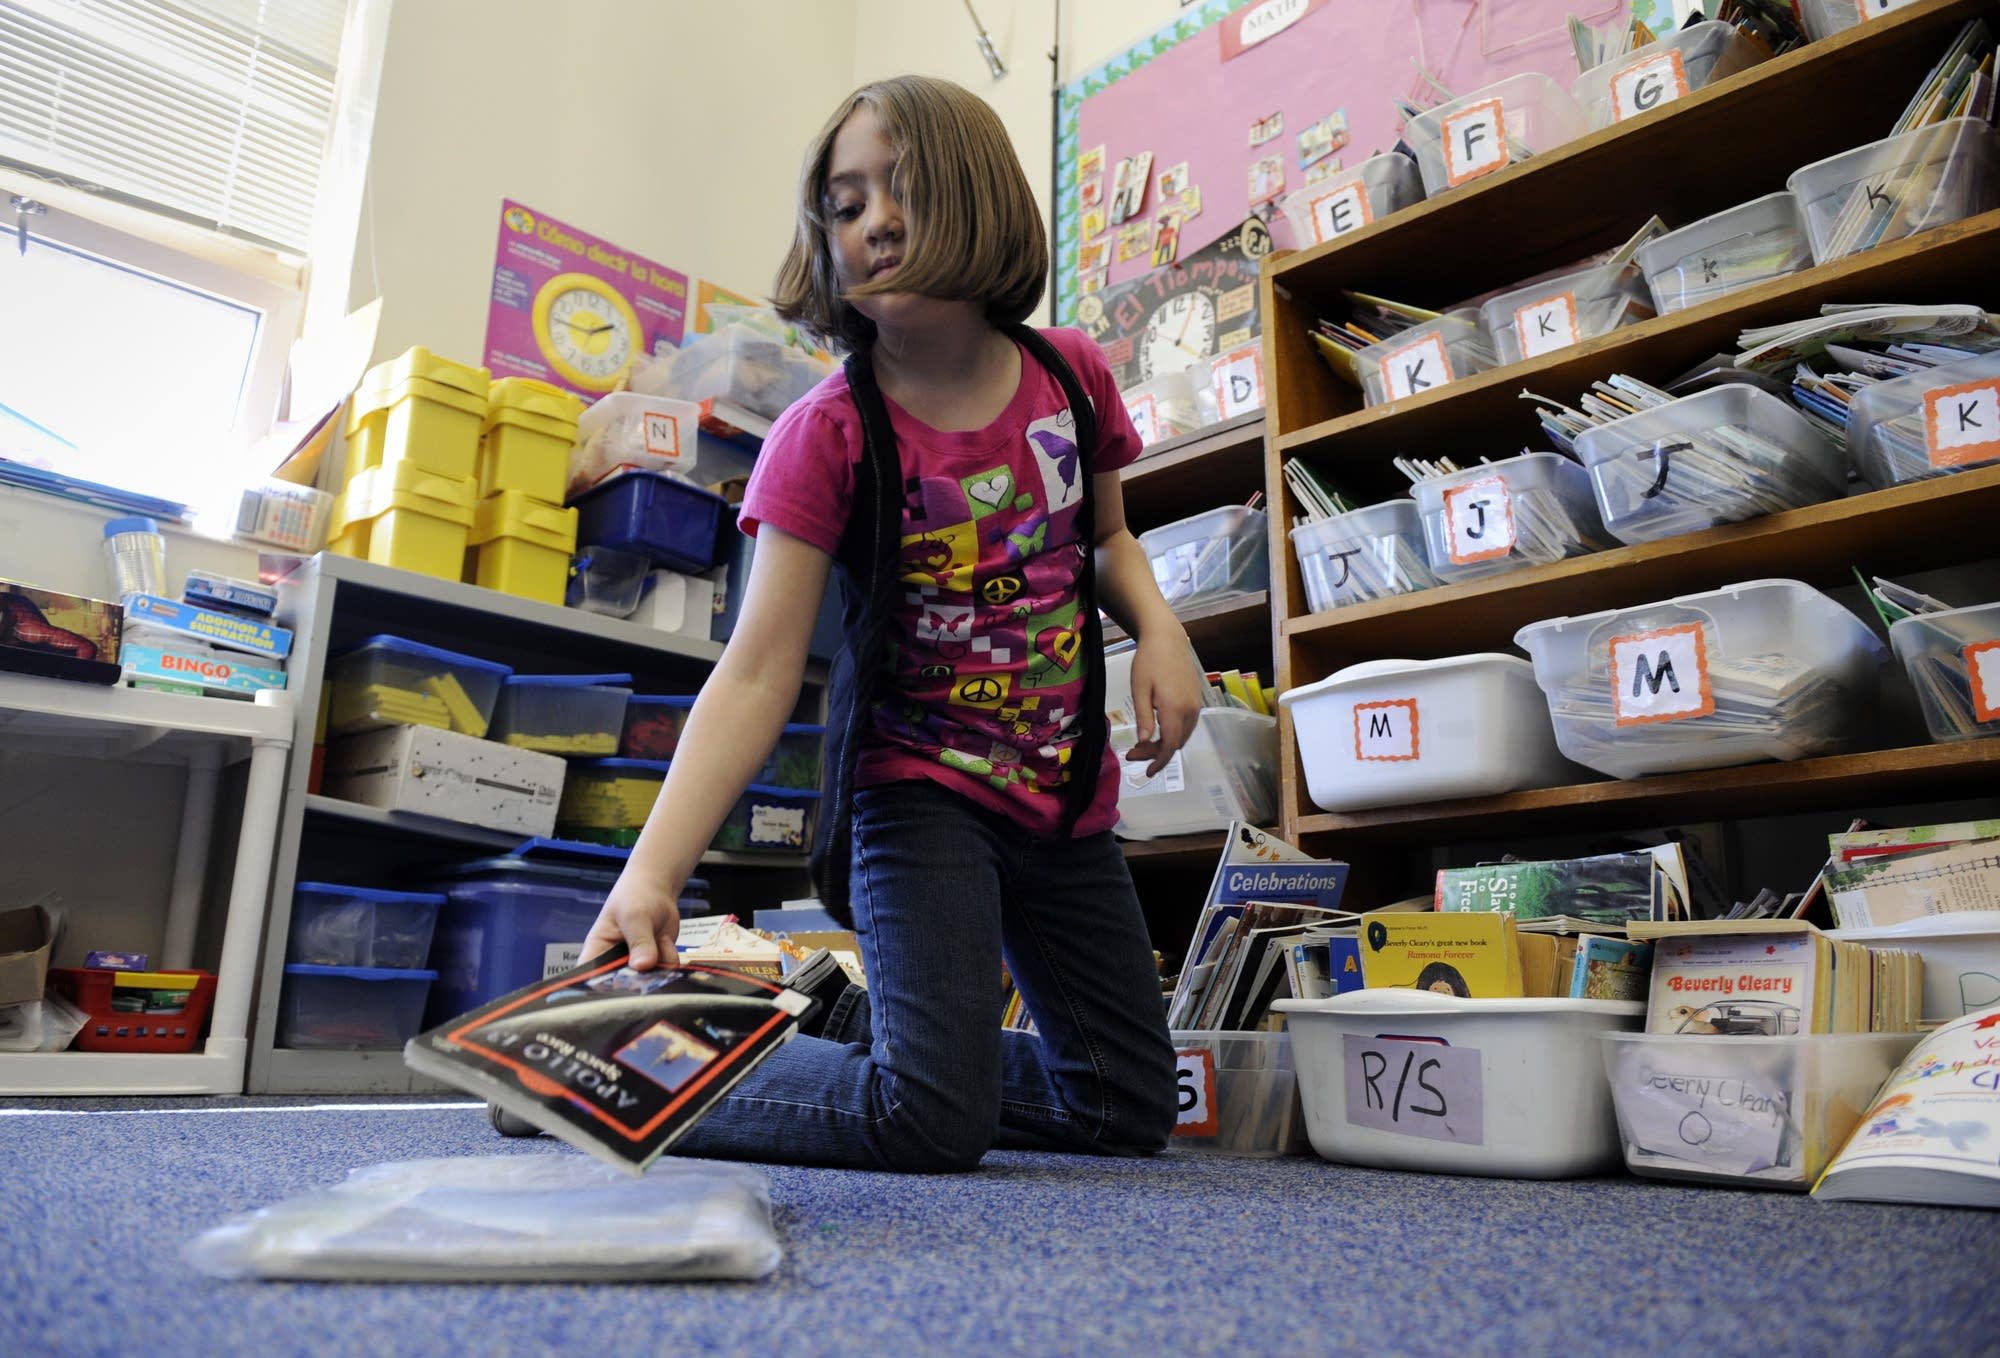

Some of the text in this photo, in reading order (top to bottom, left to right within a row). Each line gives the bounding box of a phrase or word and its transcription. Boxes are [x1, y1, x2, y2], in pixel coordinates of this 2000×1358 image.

[1634, 73, 1664, 110] G
[1464, 122, 1486, 161] F
[1866, 182, 1891, 209] K
[1330, 199, 1354, 233] E
[631, 260, 647, 283] la
[1115, 293, 1145, 331] El
[1538, 311, 1556, 338] K
[1231, 374, 1251, 403] D
[1406, 356, 1432, 395] K
[652, 423, 667, 439] N
[1958, 400, 1982, 432] K
[1636, 441, 1694, 499] J
[1466, 499, 1491, 540] J
[1328, 547, 1362, 589] J
[190, 620, 275, 650] SUBTRACTION
[196, 612, 271, 639] ADDITION &
[161, 654, 231, 680] BINGO
[1632, 650, 1680, 698] M
[1369, 713, 1393, 739] M
[1229, 871, 1337, 892] Celebrations
[1508, 874, 1518, 911] FROM
[1407, 950, 1476, 960] Ramona Forever
[1410, 938, 1435, 947] Cleary's
[1436, 939, 1455, 947] great
[1470, 938, 1488, 946] book
[739, 965, 779, 976] HELEN
[1343, 954, 1359, 973] A
[1667, 975, 1793, 995] Beverly Cleary
[523, 1043, 638, 1108] APOLLO
[1177, 1068, 1198, 1113] S
[1360, 1050, 1447, 1122] R/S
